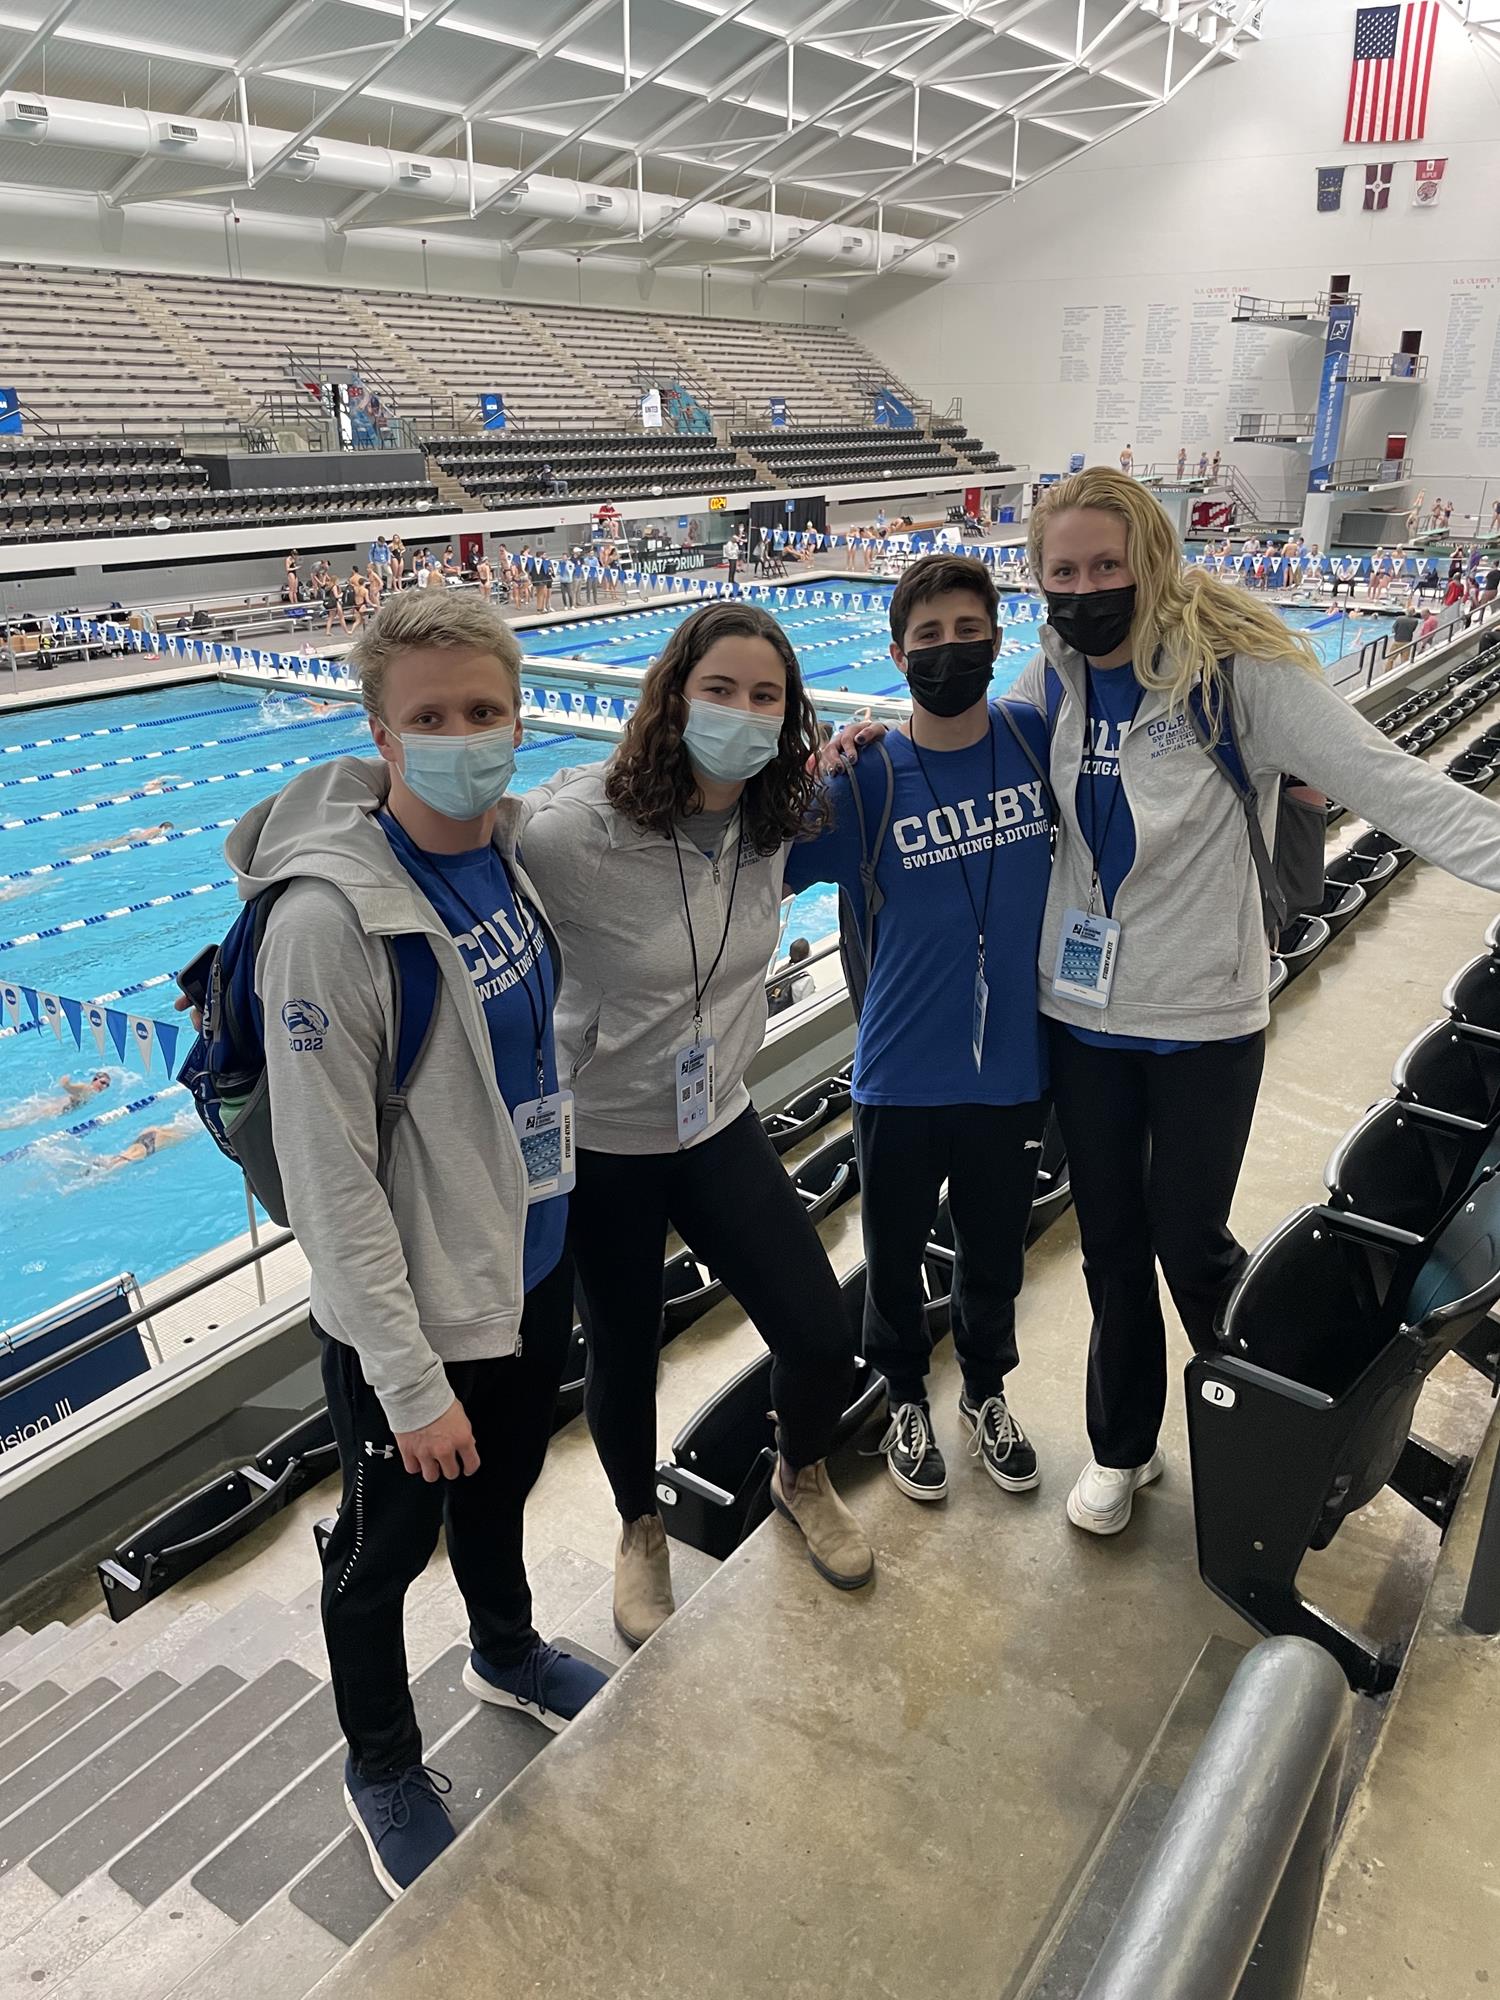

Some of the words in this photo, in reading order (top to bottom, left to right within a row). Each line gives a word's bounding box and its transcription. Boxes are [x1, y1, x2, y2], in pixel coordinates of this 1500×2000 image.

[893, 781, 1045, 853] COLBY
[289, 1037, 324, 1052] 2022
[1214, 1387, 1224, 1401] D
[664, 1489, 670, 1500] C
